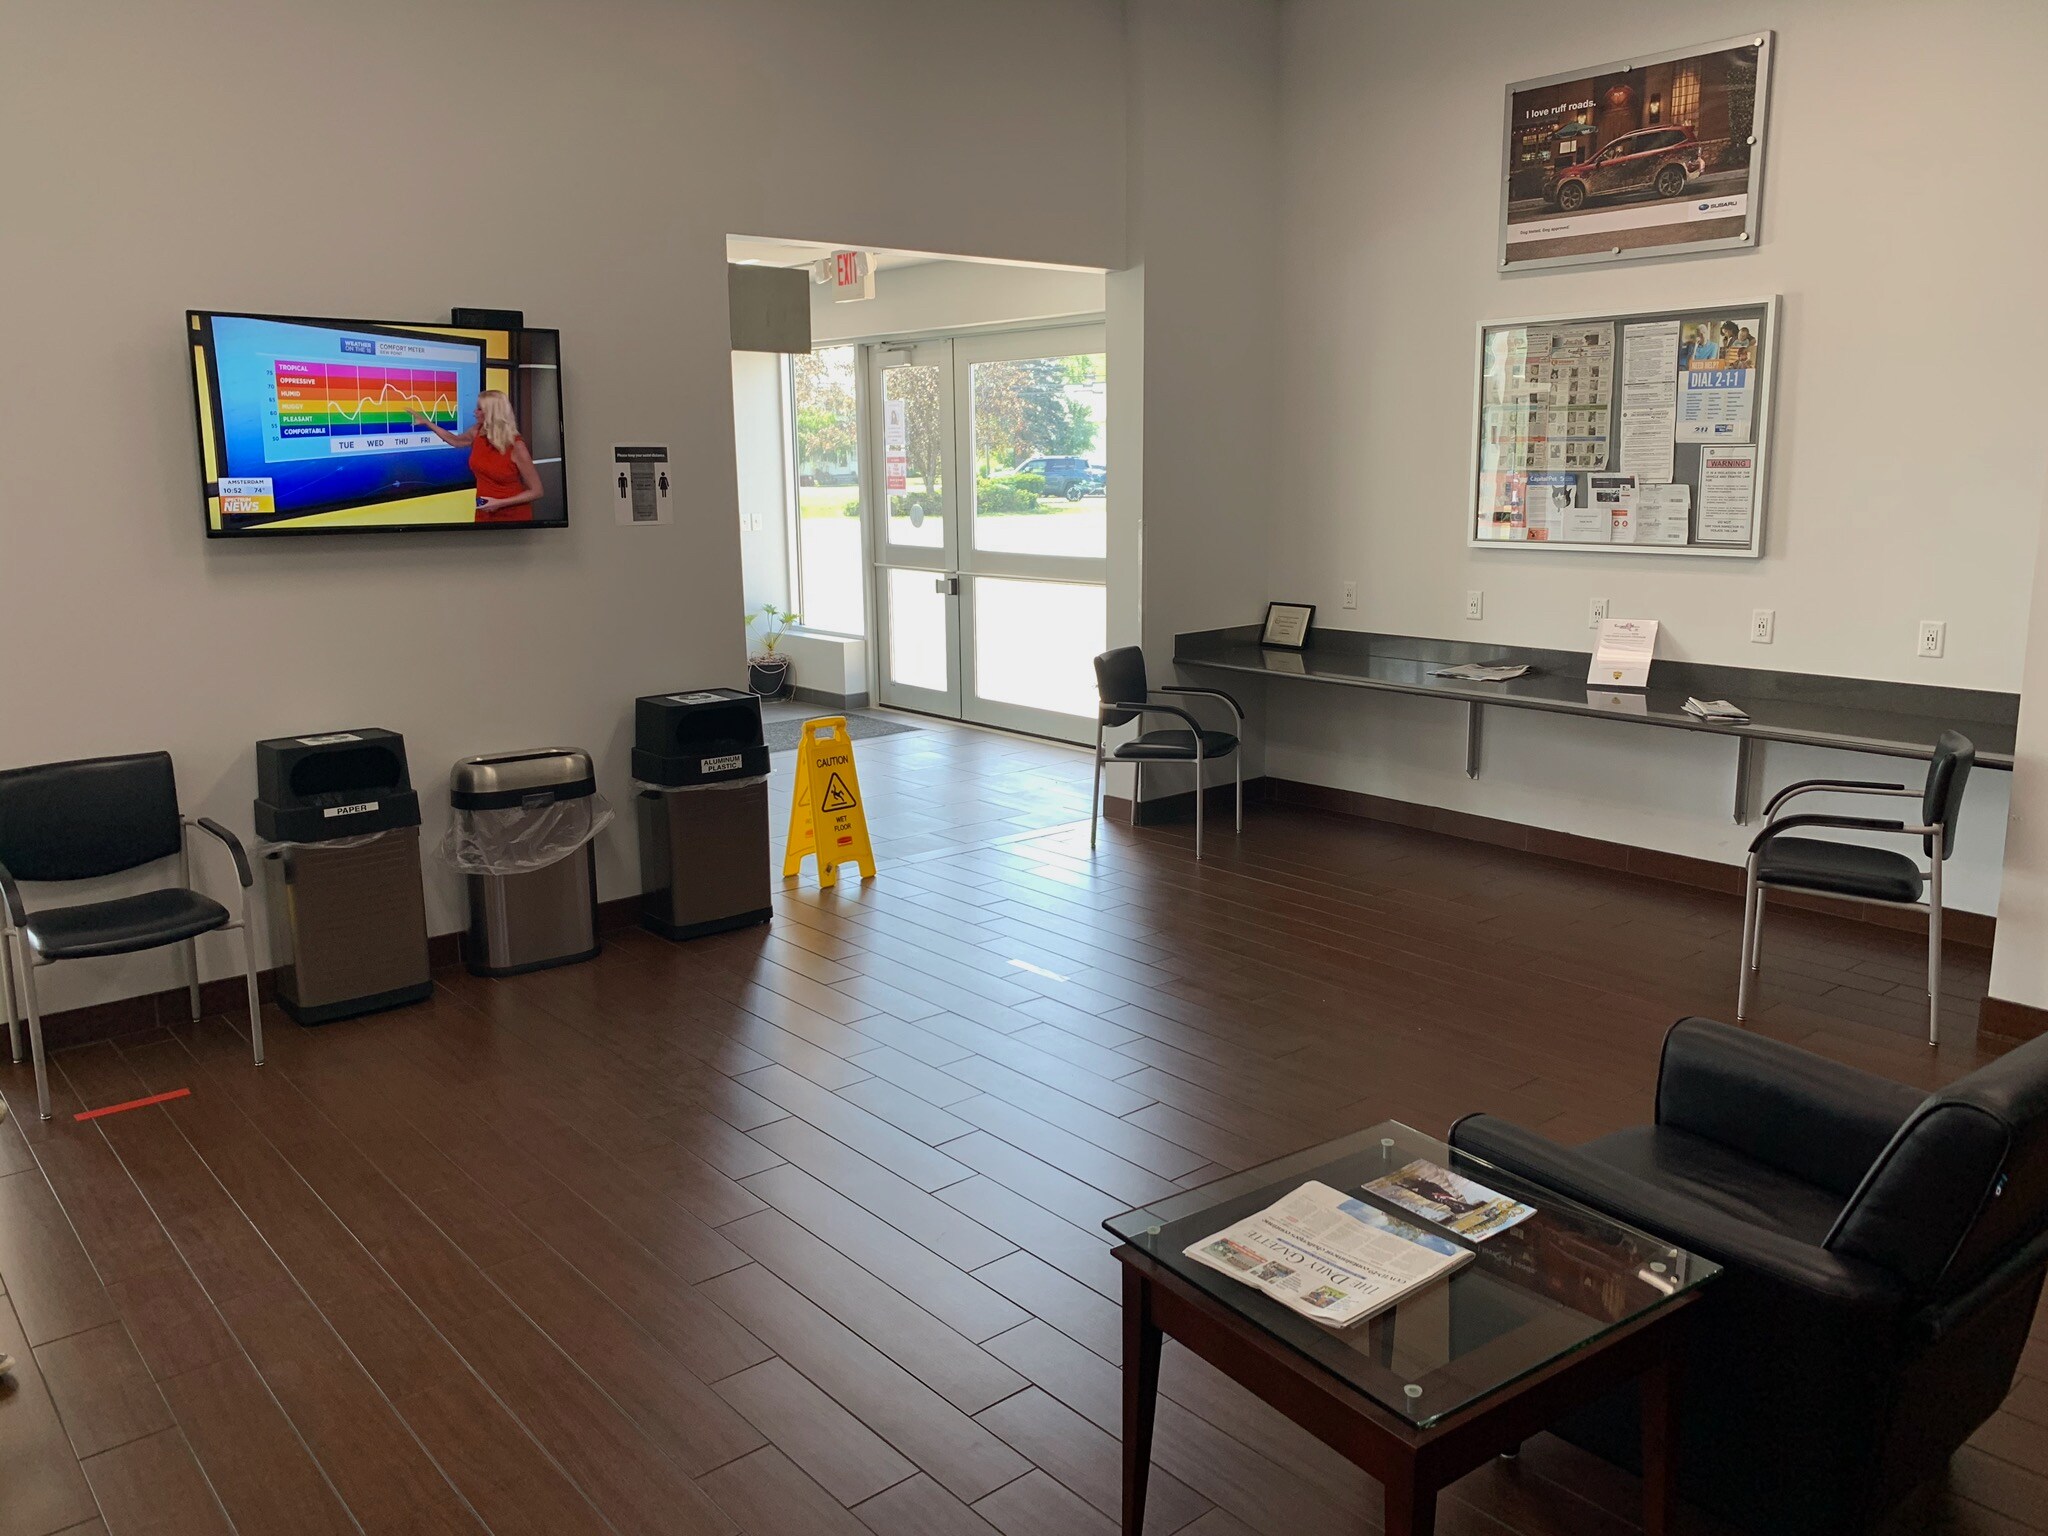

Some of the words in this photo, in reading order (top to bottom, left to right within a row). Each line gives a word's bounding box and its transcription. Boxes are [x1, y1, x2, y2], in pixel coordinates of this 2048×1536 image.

[1526, 110, 1529, 119] I
[1531, 108, 1549, 118] love
[1551, 103, 1567, 114] ruff
[1568, 99, 1596, 111] roads.
[1710, 201, 1737, 209] SUBARU
[836, 251, 857, 286] EXIT
[344, 340, 371, 348] WEATHER
[380, 343, 407, 351] COMFORT
[278, 364, 308, 372] TROPICAL
[280, 377, 316, 385] OPPRESSIVE
[1691, 372, 1713, 388] DIAL
[1715, 371, 1739, 387] 2-1-1
[339, 441, 354, 449] TUE
[367, 439, 384, 447] WED
[224, 501, 259, 512] NEWS
[704, 755, 740, 766] ALUMINUM
[816, 755, 849, 769] CAUTION
[708, 762, 737, 771] PLASTIC
[337, 804, 367, 815] PAPER
[835, 815, 847, 823] WET
[834, 824, 852, 832] FLOOR
[1248, 1229, 1305, 1264] GAZETTE
[1309, 1261, 1351, 1285] DAILY
[1353, 1281, 1380, 1295] THE
